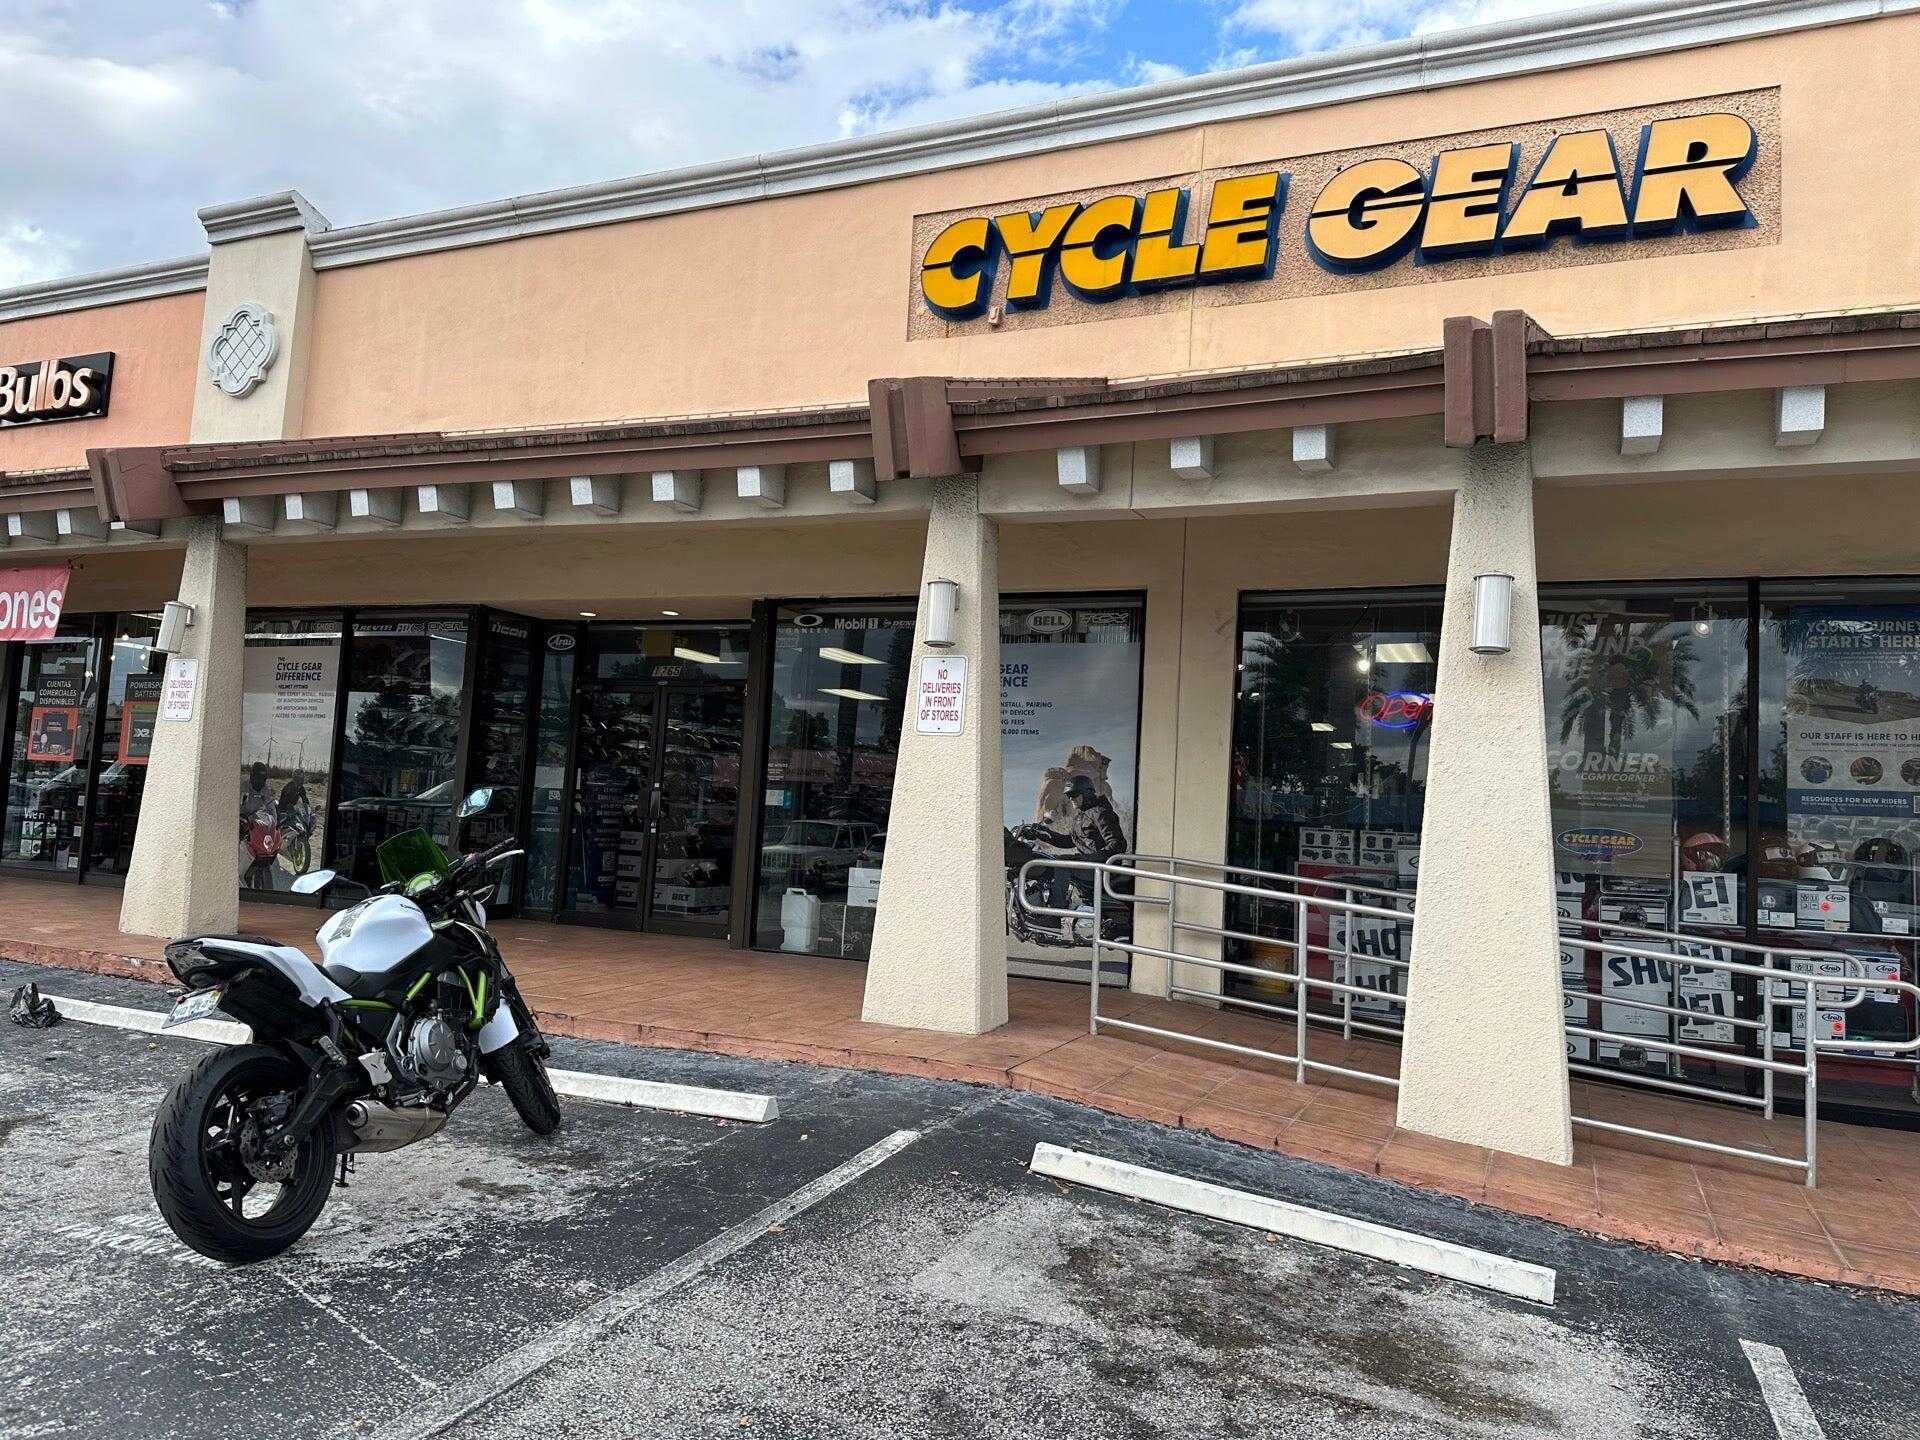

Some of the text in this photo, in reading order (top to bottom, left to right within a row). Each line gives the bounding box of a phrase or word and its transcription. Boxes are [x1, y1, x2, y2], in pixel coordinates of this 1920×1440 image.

[921, 112, 1756, 315] CYCLE GEAR
[0, 360, 95, 416] Bulbs
[835, 618, 866, 630] Mobil
[1033, 616, 1064, 626] BELL
[1808, 635, 1873, 648] STARTS
[276, 662, 323, 671] CYCLE GEAR
[275, 672, 322, 681] DIFFERENCE
[937, 668, 948, 680] NO
[46, 680, 72, 688] CUENTAS
[1000, 676, 1028, 687] NCE
[39, 689, 77, 697] COMERCIALES
[922, 682, 962, 694] DELIVERIES
[39, 697, 75, 706] DISPONIBLES
[925, 696, 957, 708] IN FRONT
[920, 709, 959, 722] OF STORES
[1800, 732, 1821, 741] OUR
[1824, 732, 1852, 741] STAFF
[1854, 733, 1864, 741] IS
[1866, 733, 1891, 741] HERE
[1893, 734, 1907, 742] TO
[1547, 750, 1659, 773] CORNER
[1801, 795, 1843, 803] RESOURCES
[1881, 797, 1907, 805] RIDERS
[1563, 833, 1636, 846] CYCLE GEAR
[672, 893, 690, 902] BILT
